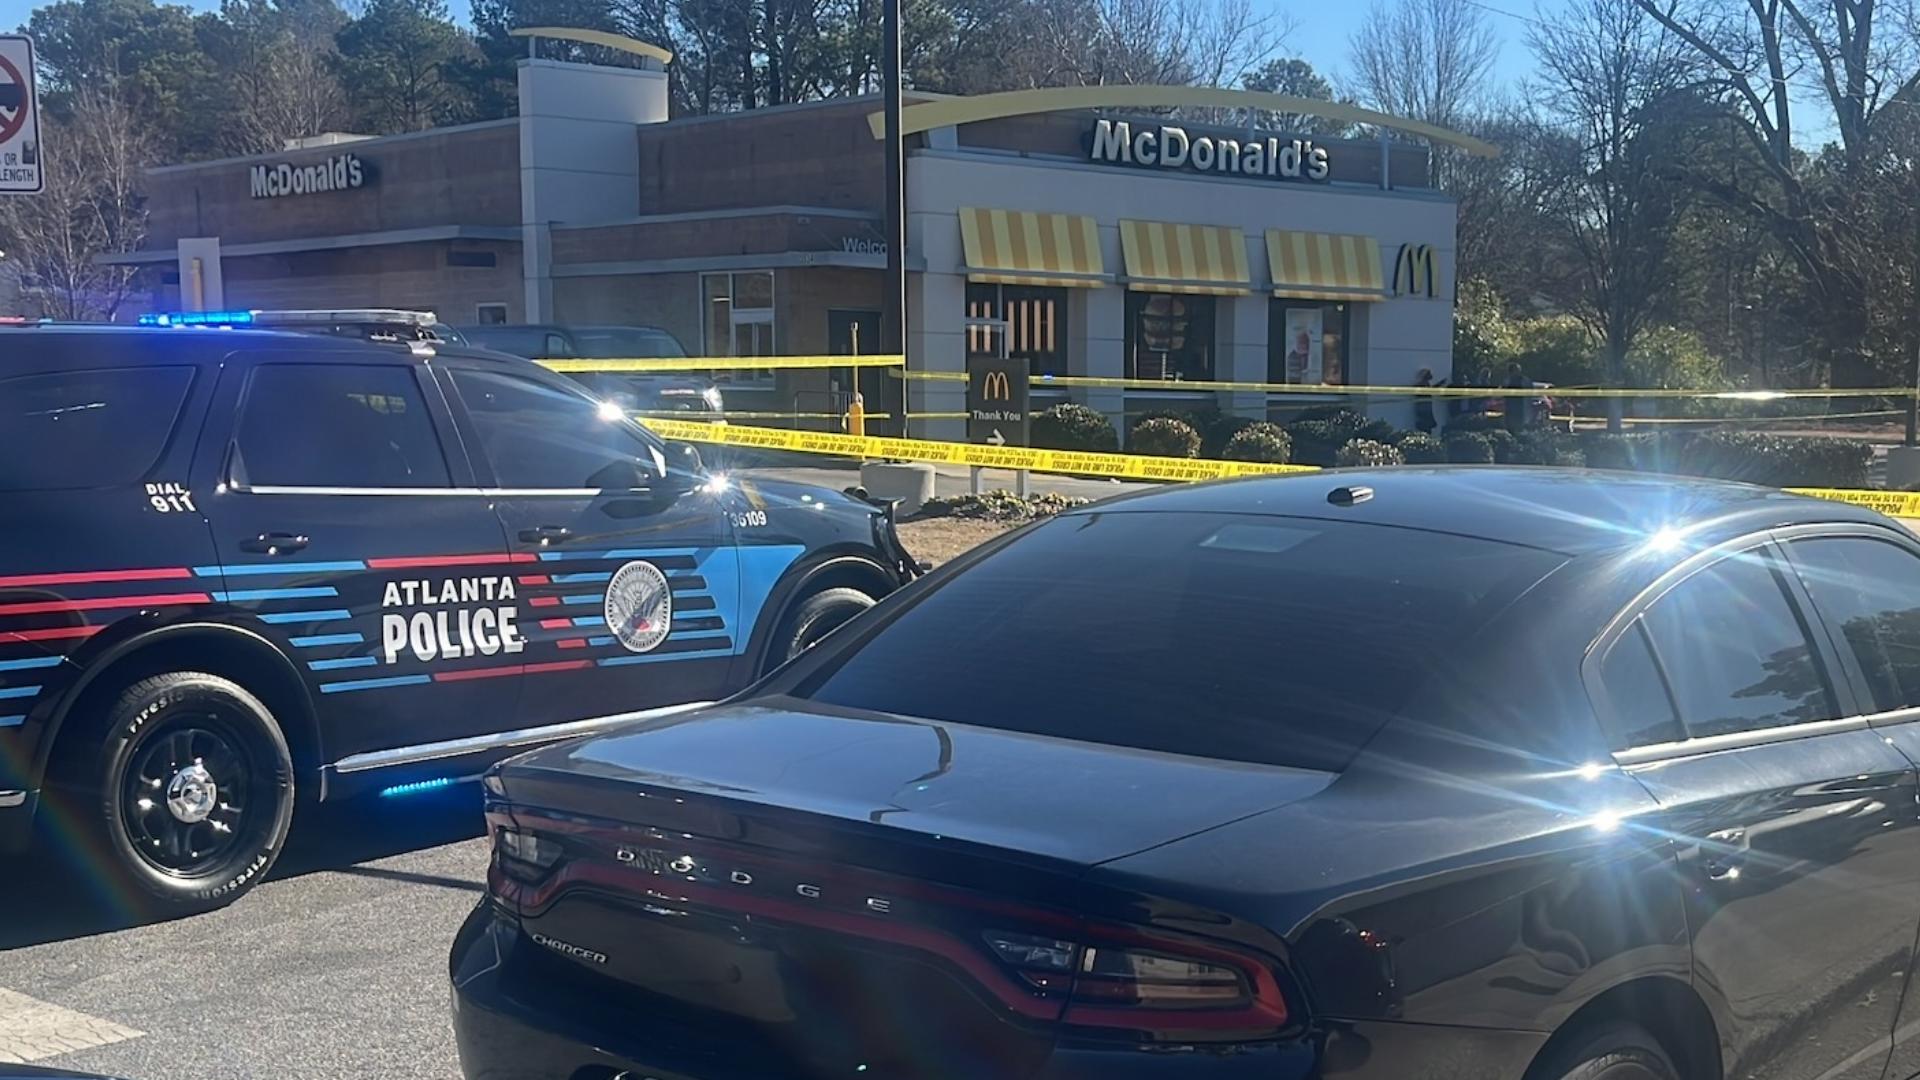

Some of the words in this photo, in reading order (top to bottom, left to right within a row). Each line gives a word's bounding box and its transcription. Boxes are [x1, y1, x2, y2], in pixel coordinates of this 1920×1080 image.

[4, 152, 18, 166] OR
[1091, 119, 1329, 180] McDonald's
[250, 154, 363, 197] McDonald's
[842, 237, 888, 256] Welco
[973, 410, 1001, 420] Thank
[1003, 411, 1022, 421] You
[145, 483, 186, 495] DIAL
[151, 495, 196, 512] 911
[730, 510, 767, 527] 36109
[382, 576, 516, 607] ATLANTA
[382, 606, 524, 664] POLICE
[191, 854, 267, 899] Fireston
[616, 848, 891, 913] DODGE
[532, 933, 607, 963] CHARGER
